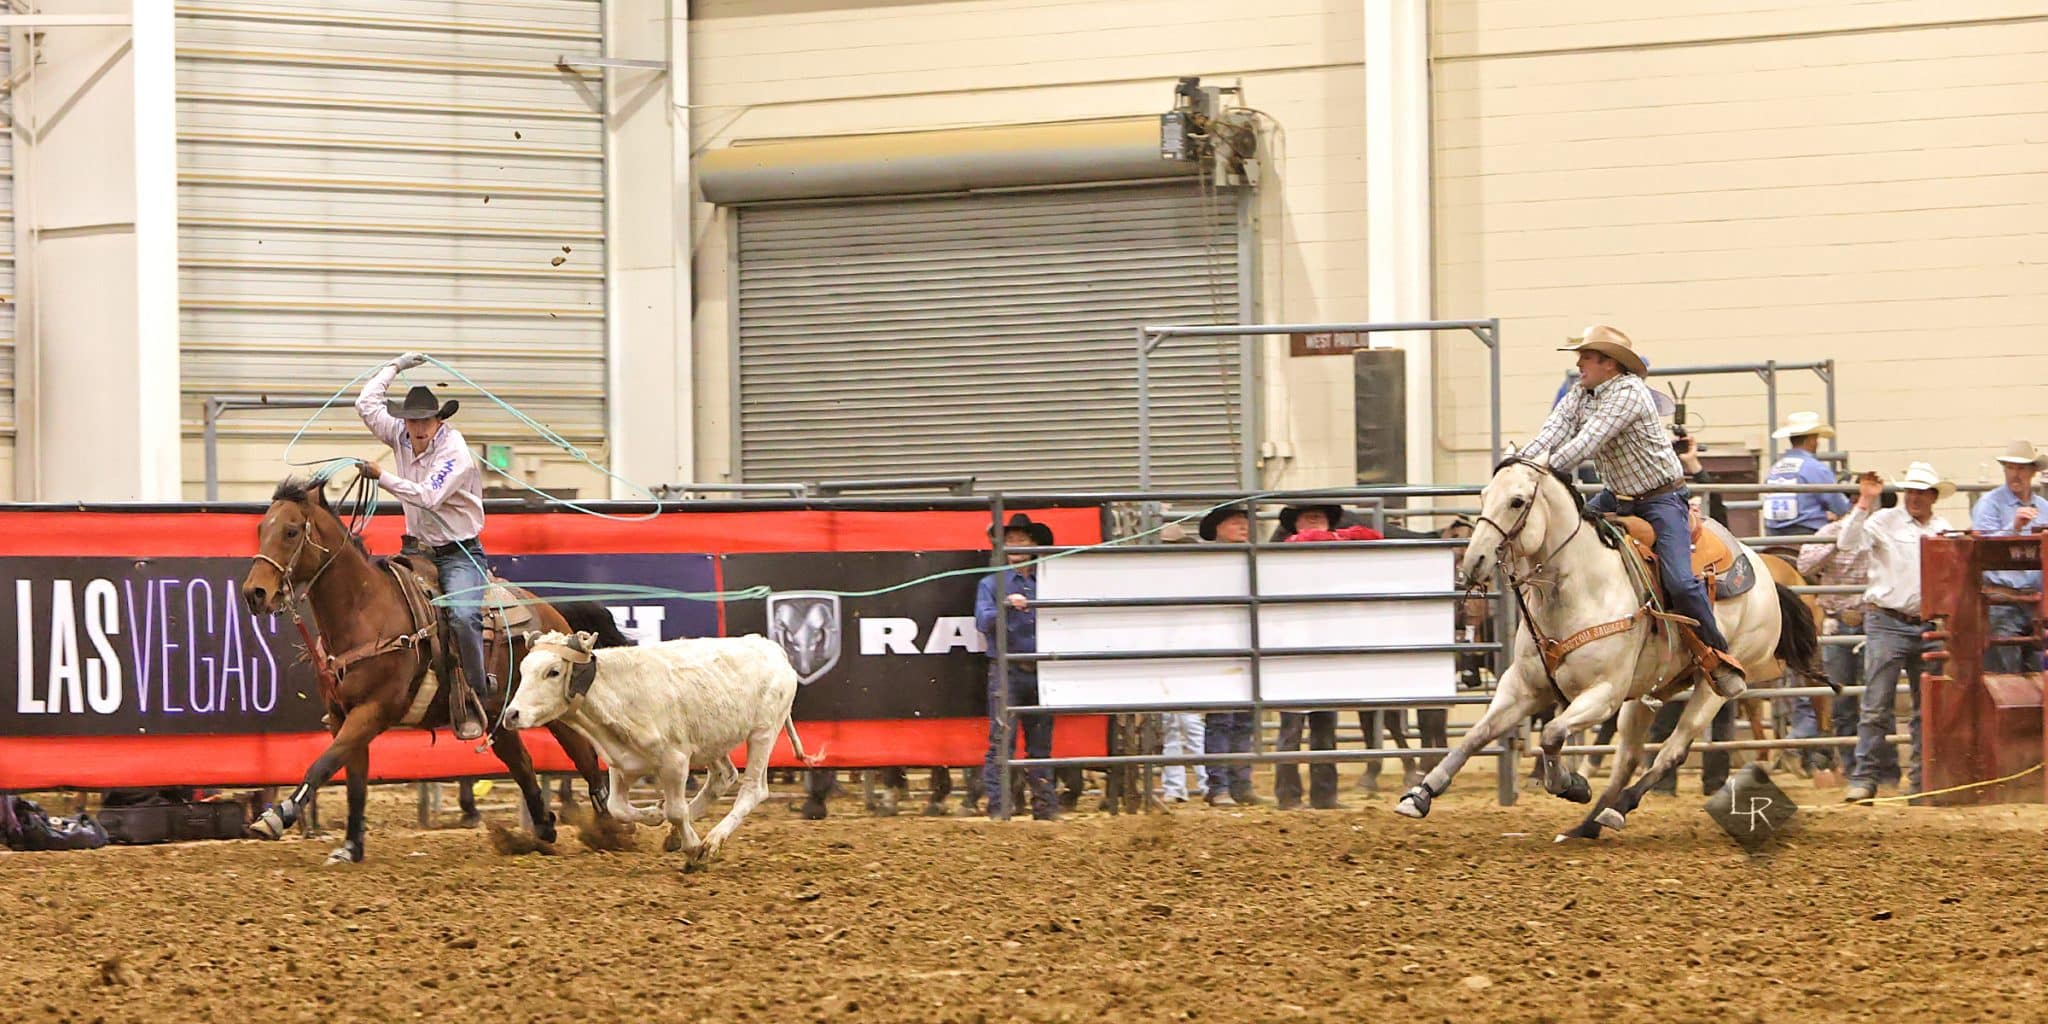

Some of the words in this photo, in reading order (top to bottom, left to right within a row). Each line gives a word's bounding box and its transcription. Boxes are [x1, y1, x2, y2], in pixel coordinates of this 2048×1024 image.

[16, 578, 123, 714] LAS
[125, 578, 278, 712] VEGAS
[859, 616, 986, 655] RA
